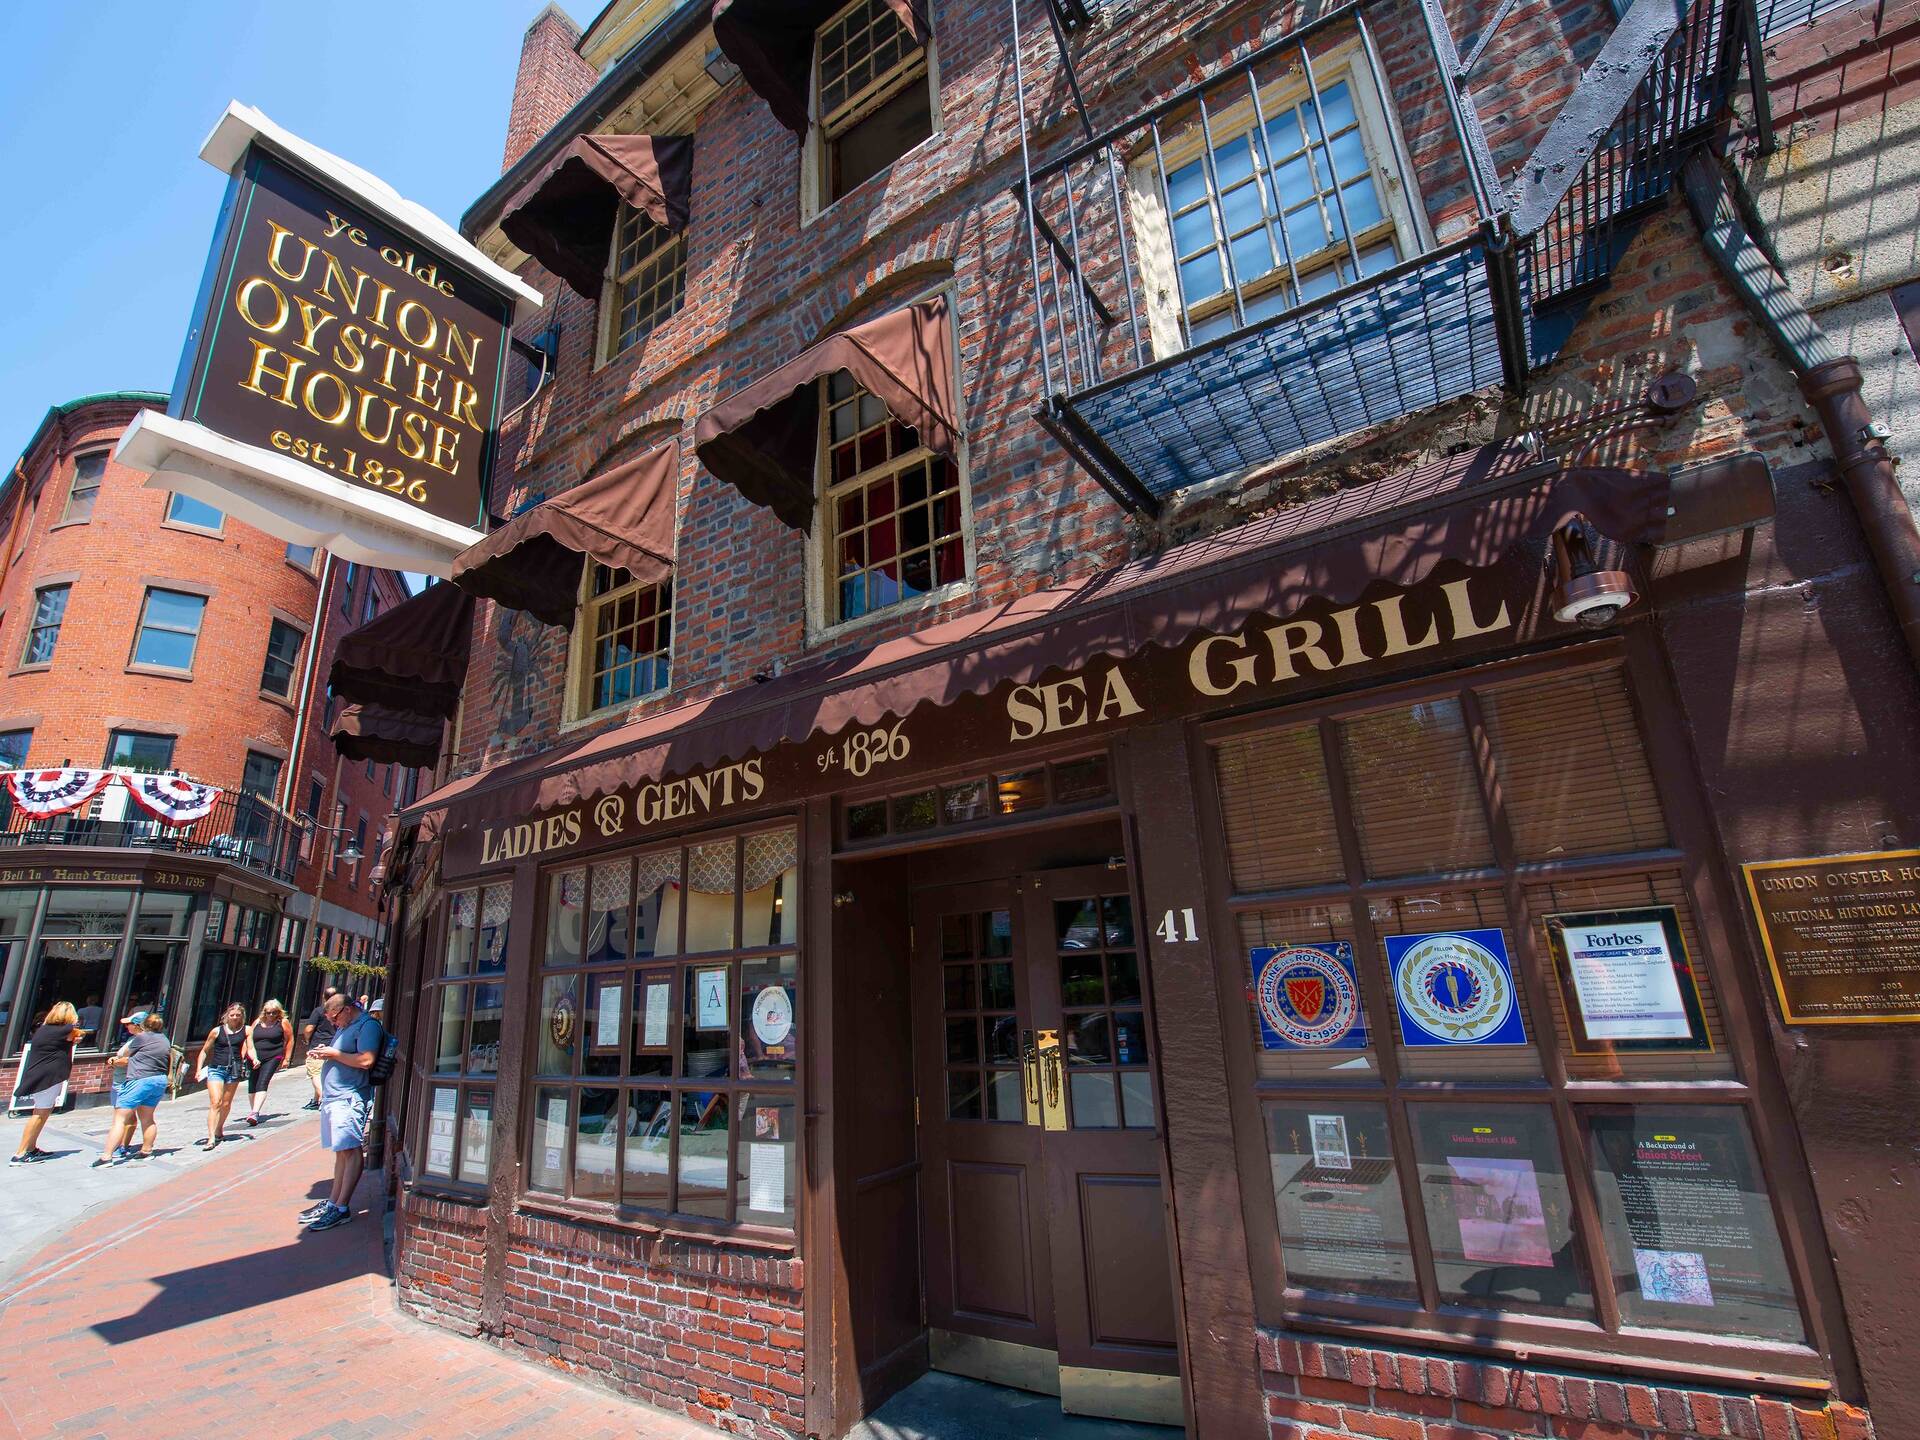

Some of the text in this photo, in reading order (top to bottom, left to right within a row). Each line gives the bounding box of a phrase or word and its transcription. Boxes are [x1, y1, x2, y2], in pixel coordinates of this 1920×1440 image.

[322, 210, 455, 298] ye olde
[266, 219, 483, 375] UNION
[235, 278, 484, 433] OYSTER
[238, 337, 461, 476] HOUSE
[1006, 576, 1512, 743] SEA GRILL
[842, 719, 912, 778] 1826
[479, 757, 765, 866] LADIES & GENTS
[1, 869, 24, 881] Bell
[53, 868, 89, 881] Hand
[92, 870, 137, 881] Tavern
[185, 877, 206, 888] 1795
[1762, 875, 1818, 891] UNION
[1826, 869, 1893, 886] OYSTER
[1156, 907, 1199, 943] 41
[1771, 908, 1834, 923] NATIONAL
[1838, 904, 1897, 919] HISTORIC
[1586, 933, 1644, 948] Forbes
[1264, 964, 1282, 1004] CHAINE
[1295, 954, 1350, 1000] ROTISSEURS
[1880, 982, 1903, 990] 2003
[1842, 994, 1887, 1002] NATIONAL
[1889, 993, 1911, 1001] PARK
[1636, 1150, 1703, 1161] Union Street
[1645, 1141, 1686, 1150] Background
[1688, 1142, 1696, 1150] of
